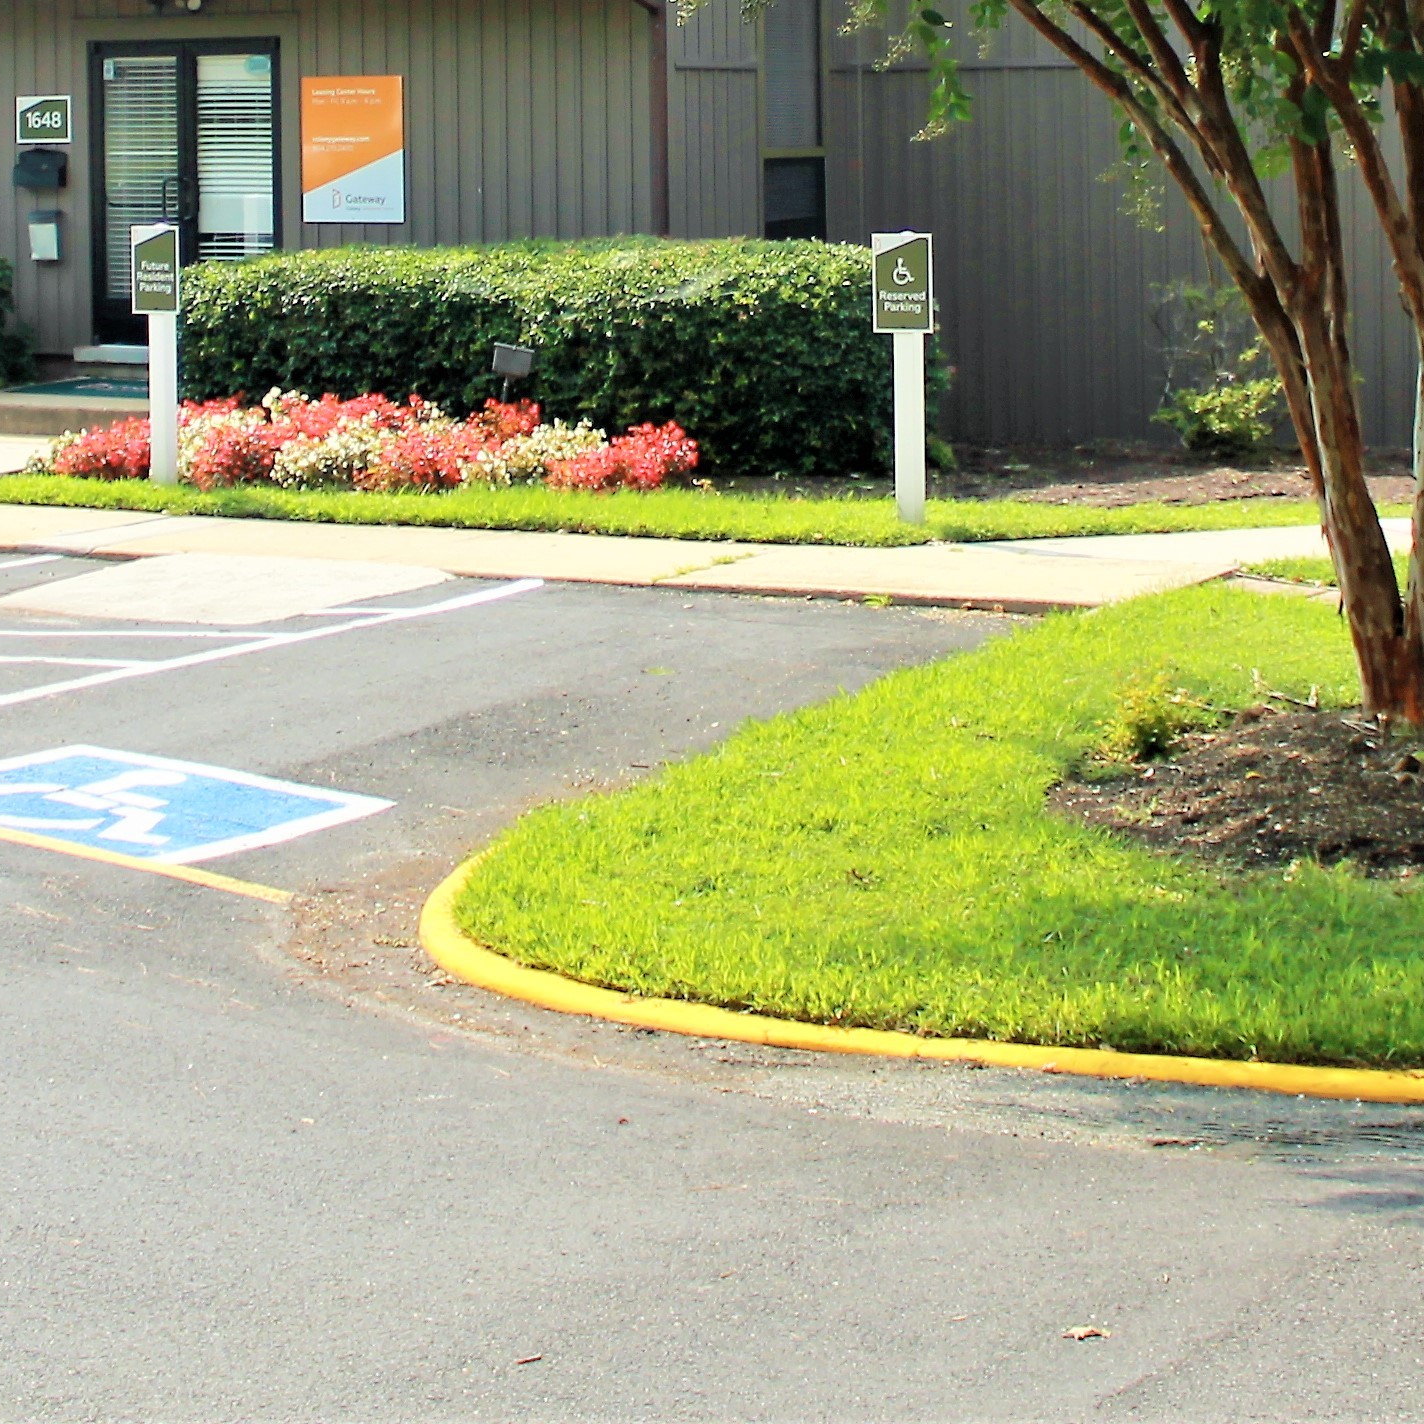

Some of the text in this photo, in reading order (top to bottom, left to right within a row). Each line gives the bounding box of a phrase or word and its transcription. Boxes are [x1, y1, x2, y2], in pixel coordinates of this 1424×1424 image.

[26, 111, 62, 128] 1648
[345, 194, 386, 206] Gateway
[141, 260, 169, 271] Future
[136, 271, 174, 282] Resident
[139, 281, 172, 295] Parking
[879, 290, 926, 301] Reserved
[884, 301, 922, 315] Parking
